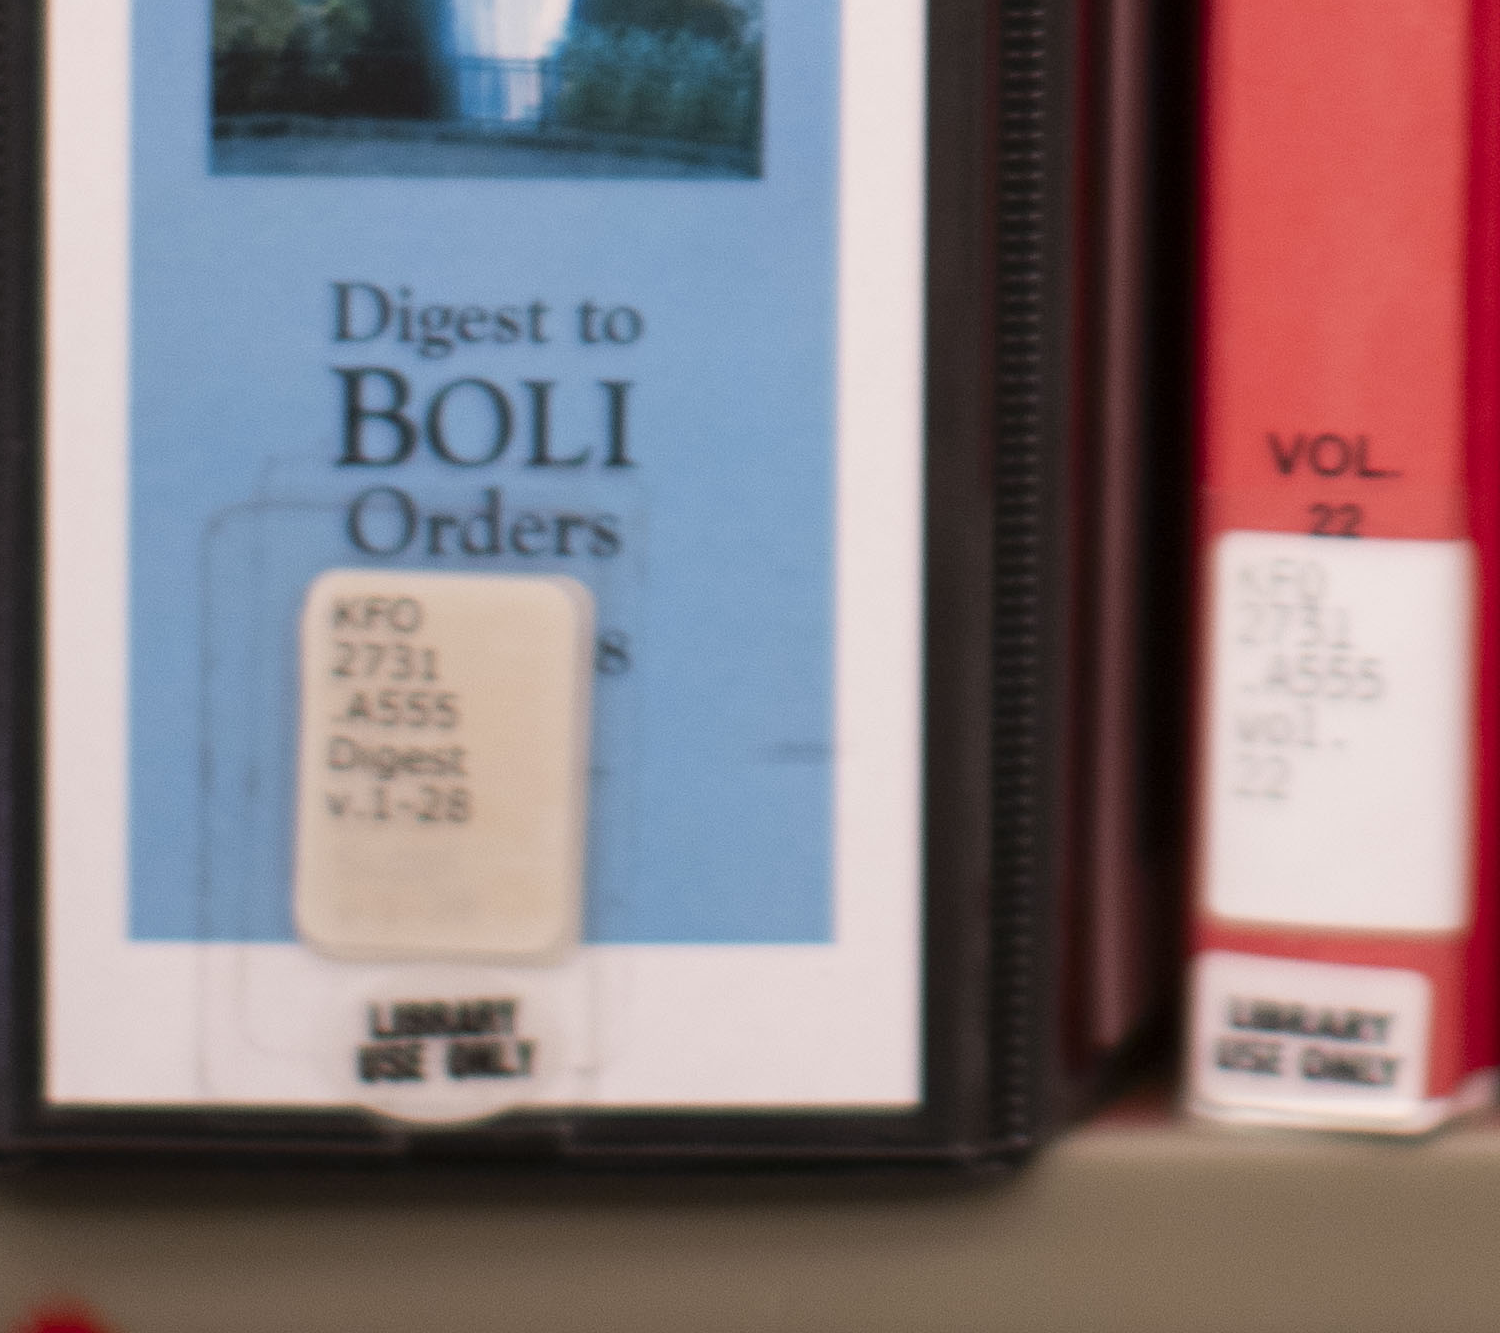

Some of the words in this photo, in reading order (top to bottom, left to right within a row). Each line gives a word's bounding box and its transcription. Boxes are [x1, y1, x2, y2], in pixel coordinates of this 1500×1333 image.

[330, 280, 547, 360] Digest
[578, 291, 642, 345] to
[331, 366, 637, 471] BOLI
[347, 486, 621, 559] Orders
[1308, 503, 1363, 539] 22
[331, 595, 422, 633] KFO
[331, 643, 440, 681] 2731
[331, 692, 461, 729] .A555
[328, 737, 468, 782] Digest
[368, 999, 519, 1040] LIBRARY
[356, 1044, 425, 1083] USE
[446, 1041, 536, 1080] ONLY
